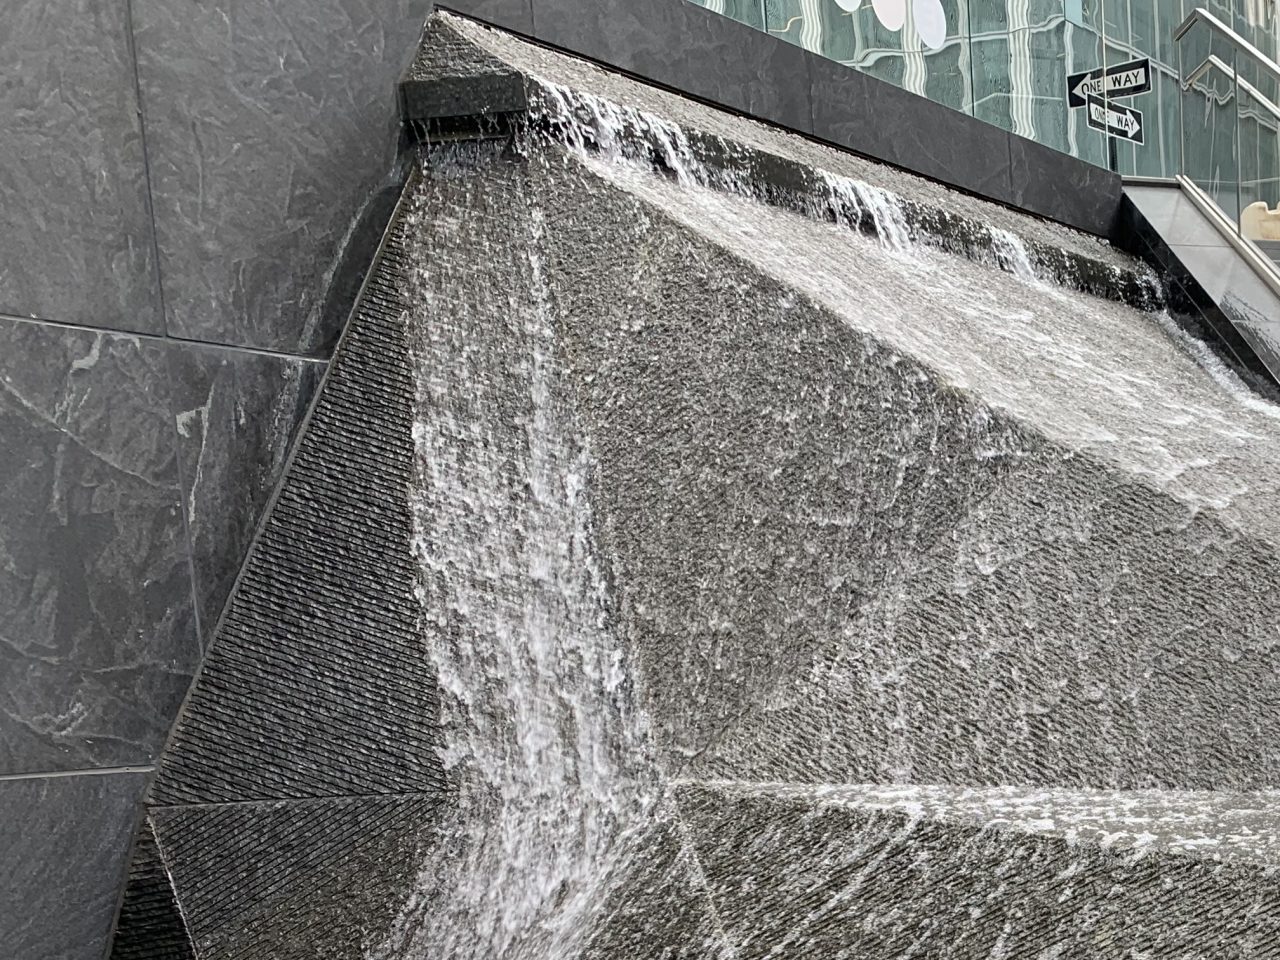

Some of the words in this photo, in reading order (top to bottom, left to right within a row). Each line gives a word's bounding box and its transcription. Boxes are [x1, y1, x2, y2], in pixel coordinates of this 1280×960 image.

[1081, 80, 1102, 96] ONE
[1112, 70, 1140, 87] WAY
[1095, 107, 1110, 124] ONE
[1116, 115, 1135, 131] WAY
